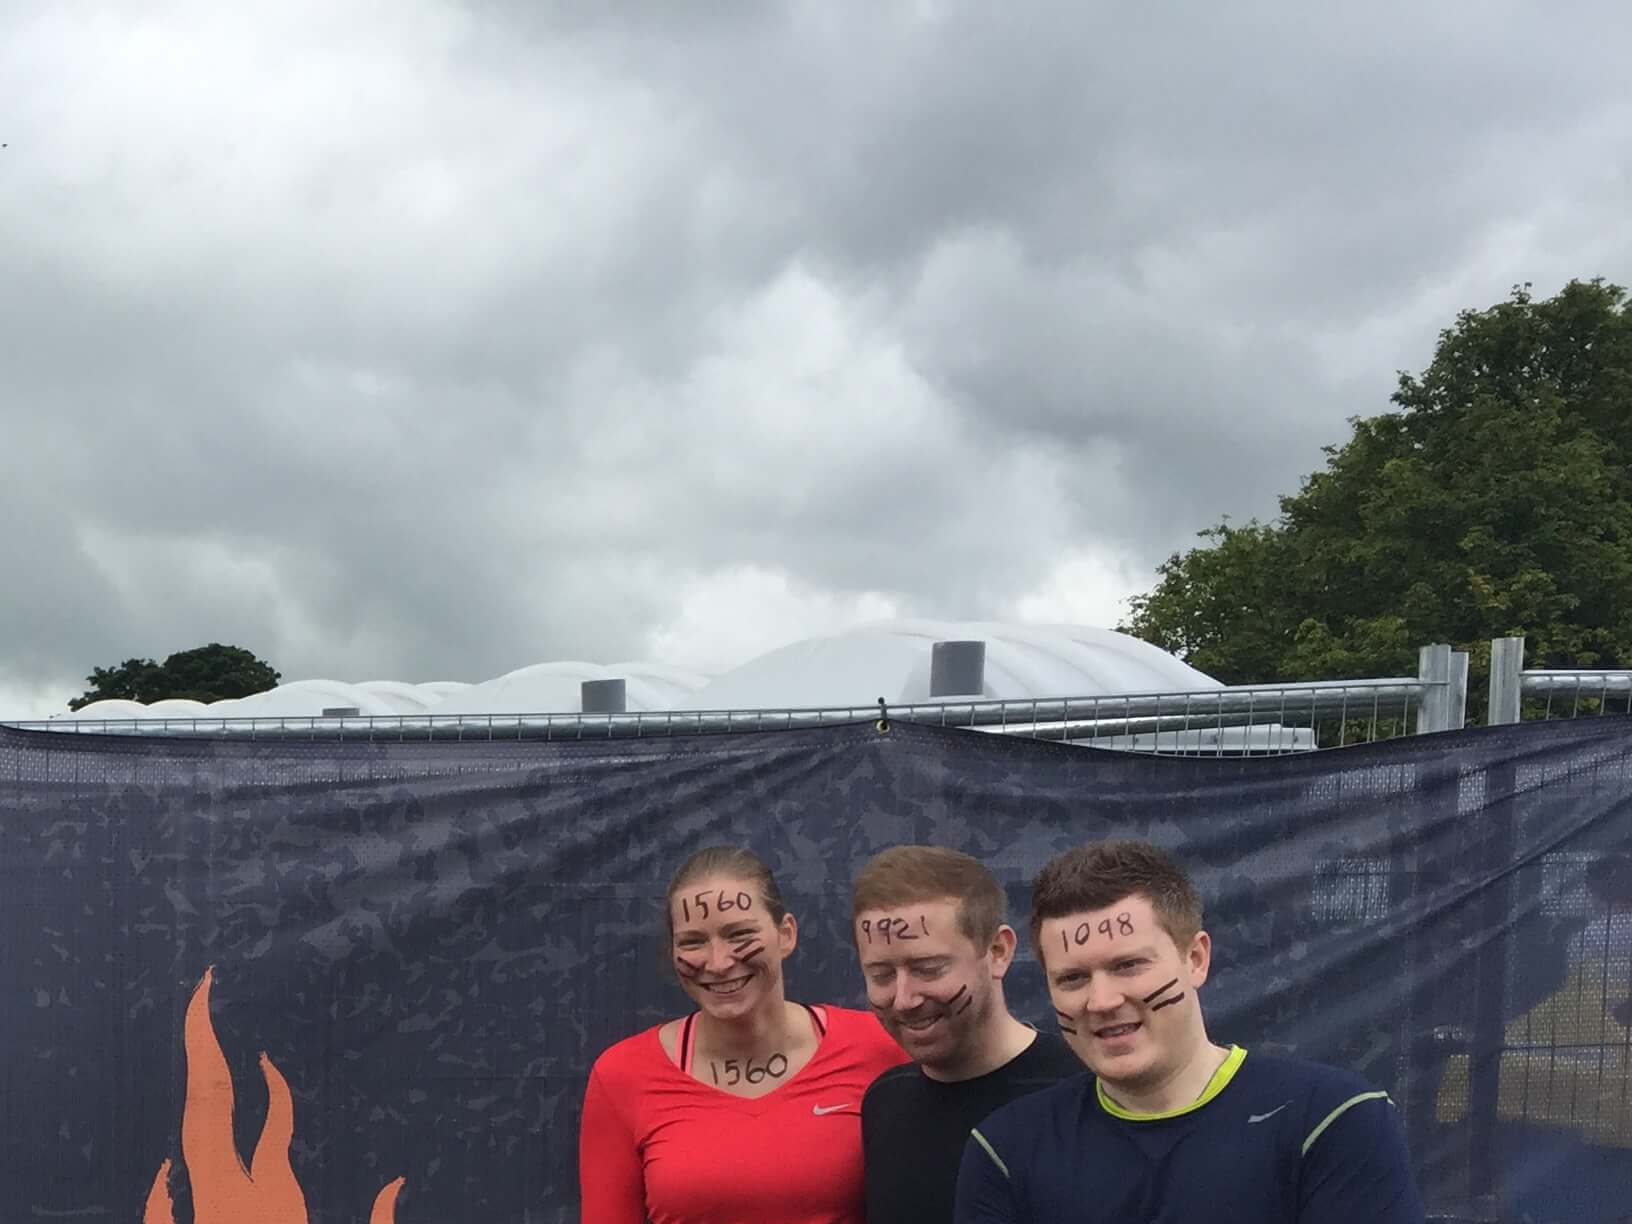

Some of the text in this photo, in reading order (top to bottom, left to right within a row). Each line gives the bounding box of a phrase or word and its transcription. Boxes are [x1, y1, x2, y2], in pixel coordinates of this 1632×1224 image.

[681, 890, 753, 923] 1560
[860, 914, 930, 945] 9921
[1061, 911, 1136, 953] 1098
[709, 1052, 789, 1086] 1560
